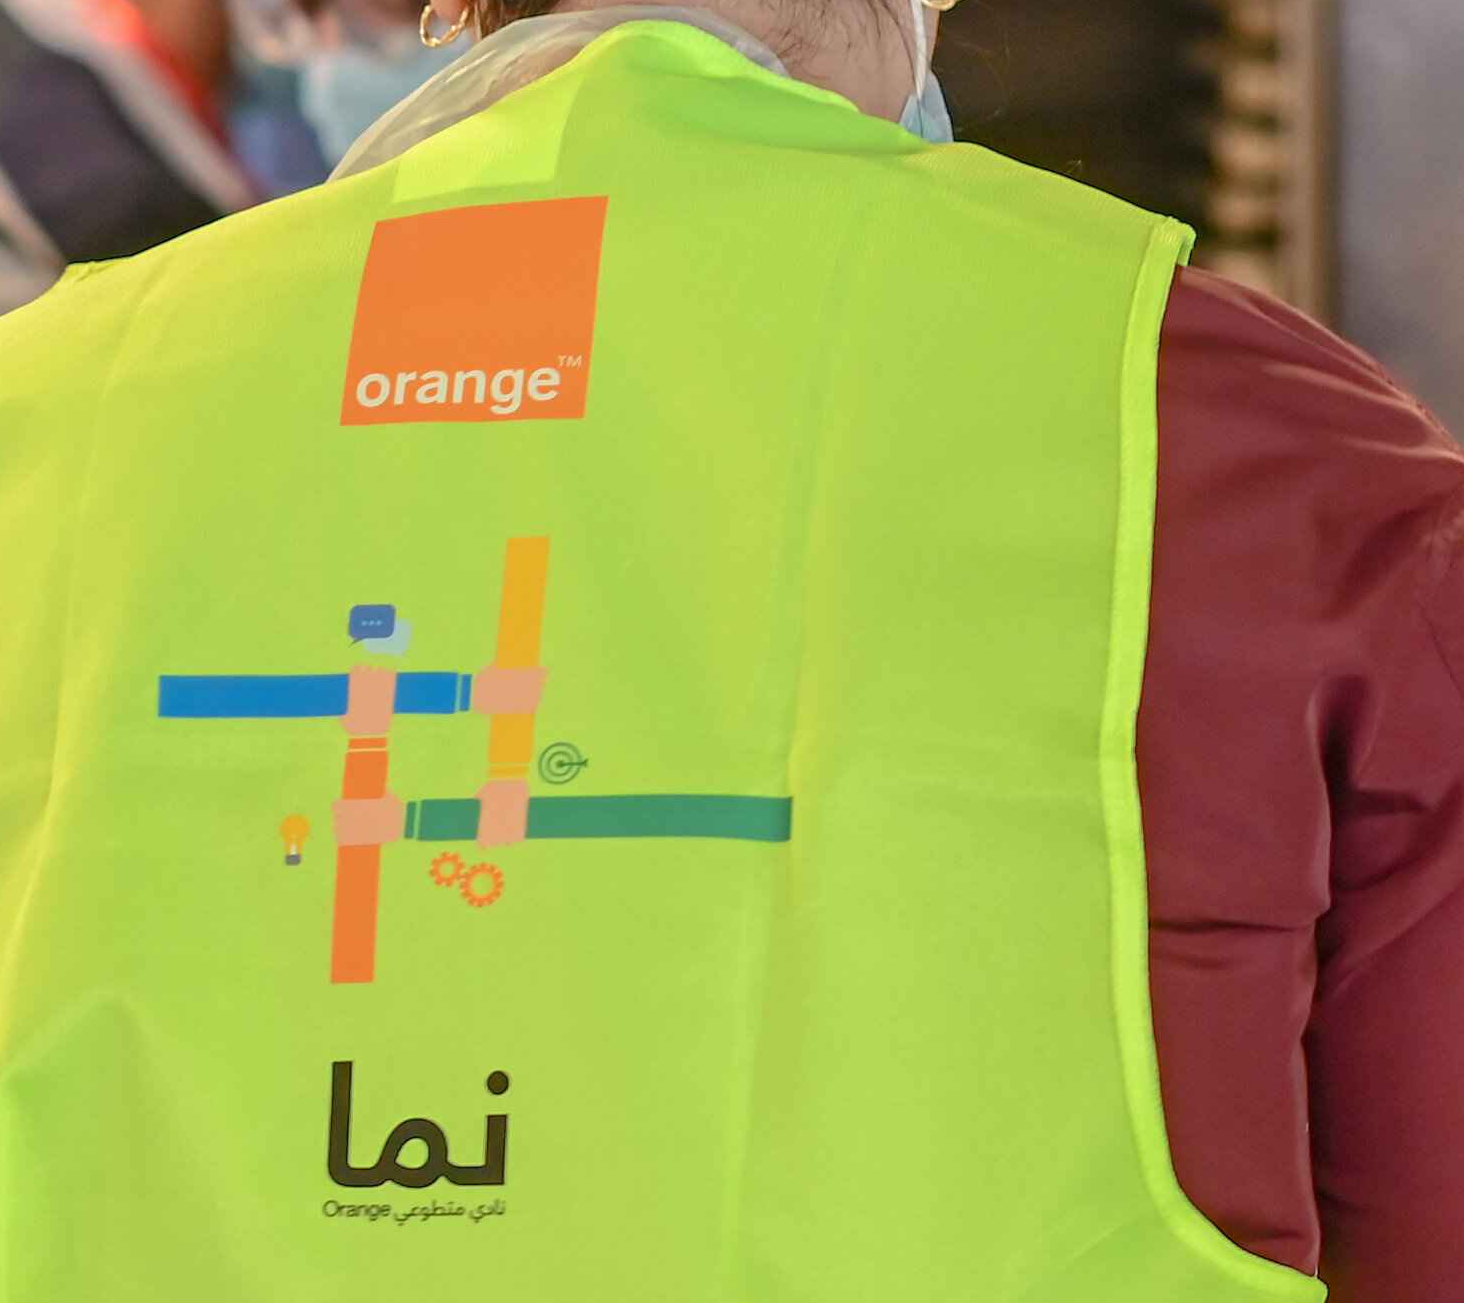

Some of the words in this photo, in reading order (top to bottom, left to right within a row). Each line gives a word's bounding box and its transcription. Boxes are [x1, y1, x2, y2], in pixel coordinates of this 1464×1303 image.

[355, 366, 563, 416] orange
[325, 1059, 510, 1190] نما
[322, 1199, 392, 1222] Orange
